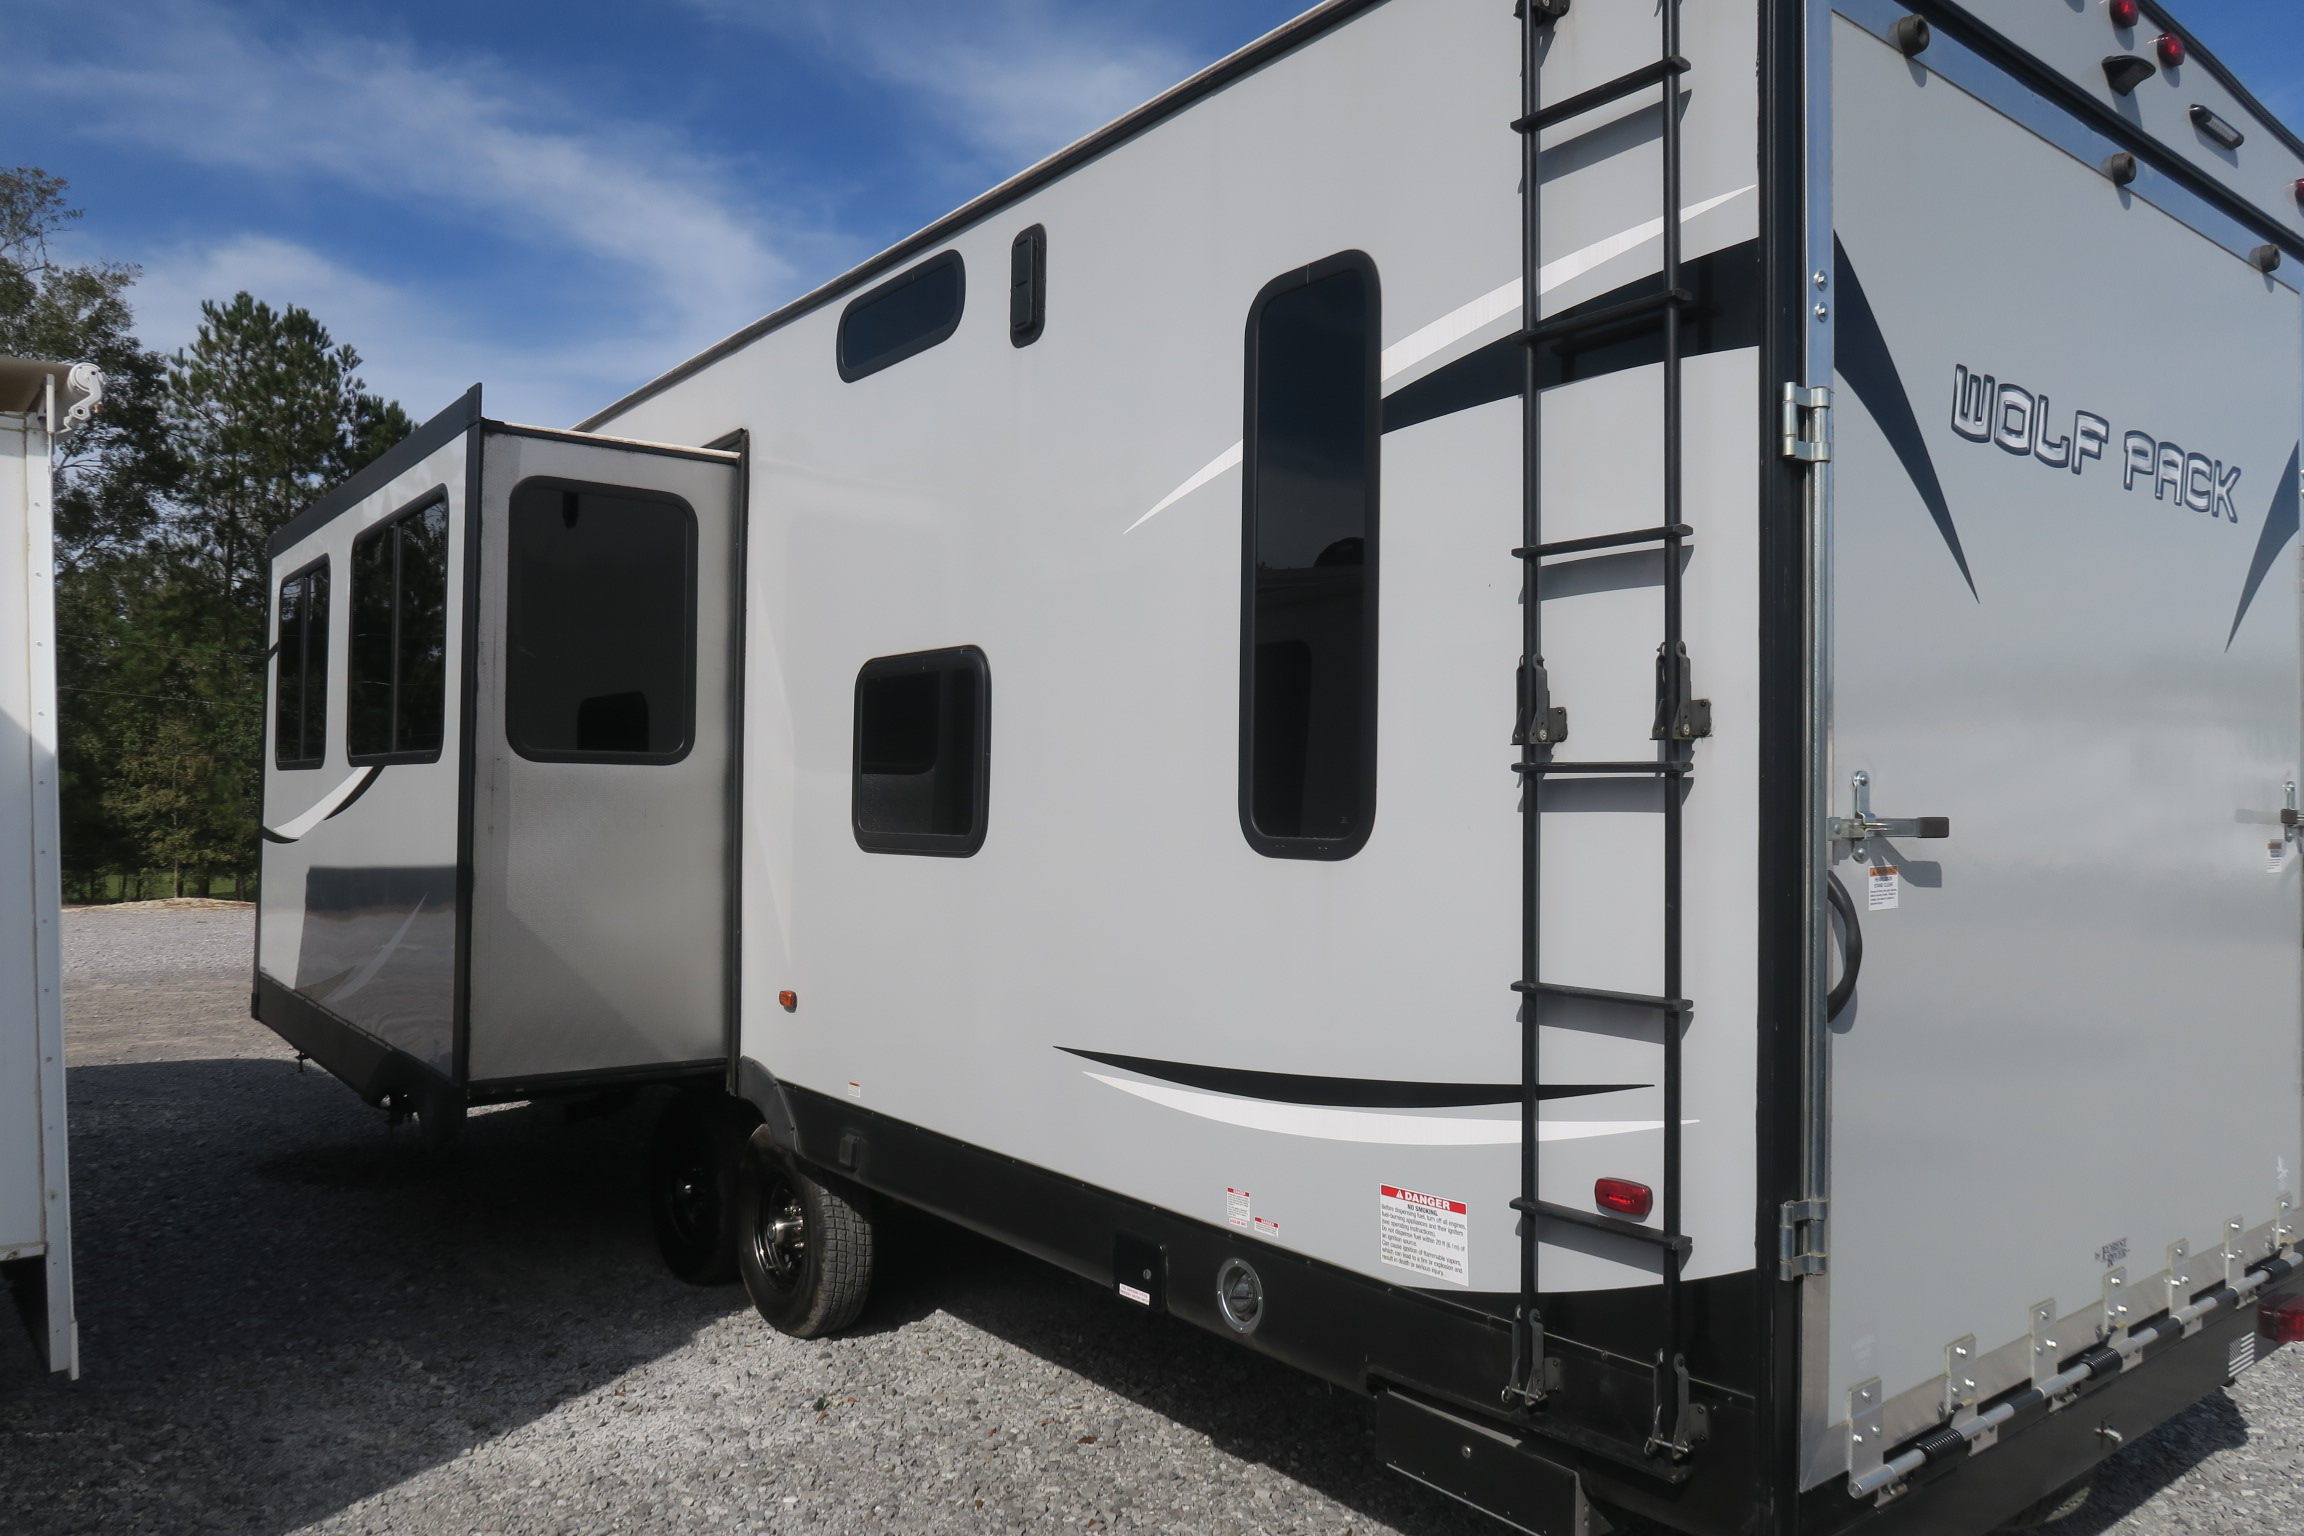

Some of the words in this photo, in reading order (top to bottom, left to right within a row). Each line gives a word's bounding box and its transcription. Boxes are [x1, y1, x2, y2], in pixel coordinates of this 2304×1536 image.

[1951, 363, 2109, 475] WOLF
[2123, 430, 2241, 523] PACK
[1405, 1192, 1451, 1210] DANGER
[1395, 1208, 1416, 1218] dispensing
[1382, 1211, 1405, 1223] fuel-burning
[1406, 1218, 1427, 1227] appliances
[1448, 1228, 1463, 1237] igniters
[1391, 1222, 1409, 1231] operating
[1388, 1234, 1402, 1242] ignition
[1395, 1229, 1412, 1238] dispense
[1403, 1245, 1417, 1254] ignition
[1424, 1250, 1445, 1261] flammable
[1399, 1258, 1409, 1266] death
[1416, 1264, 1430, 1272] serious
[1434, 1262, 1453, 1271] explosion
